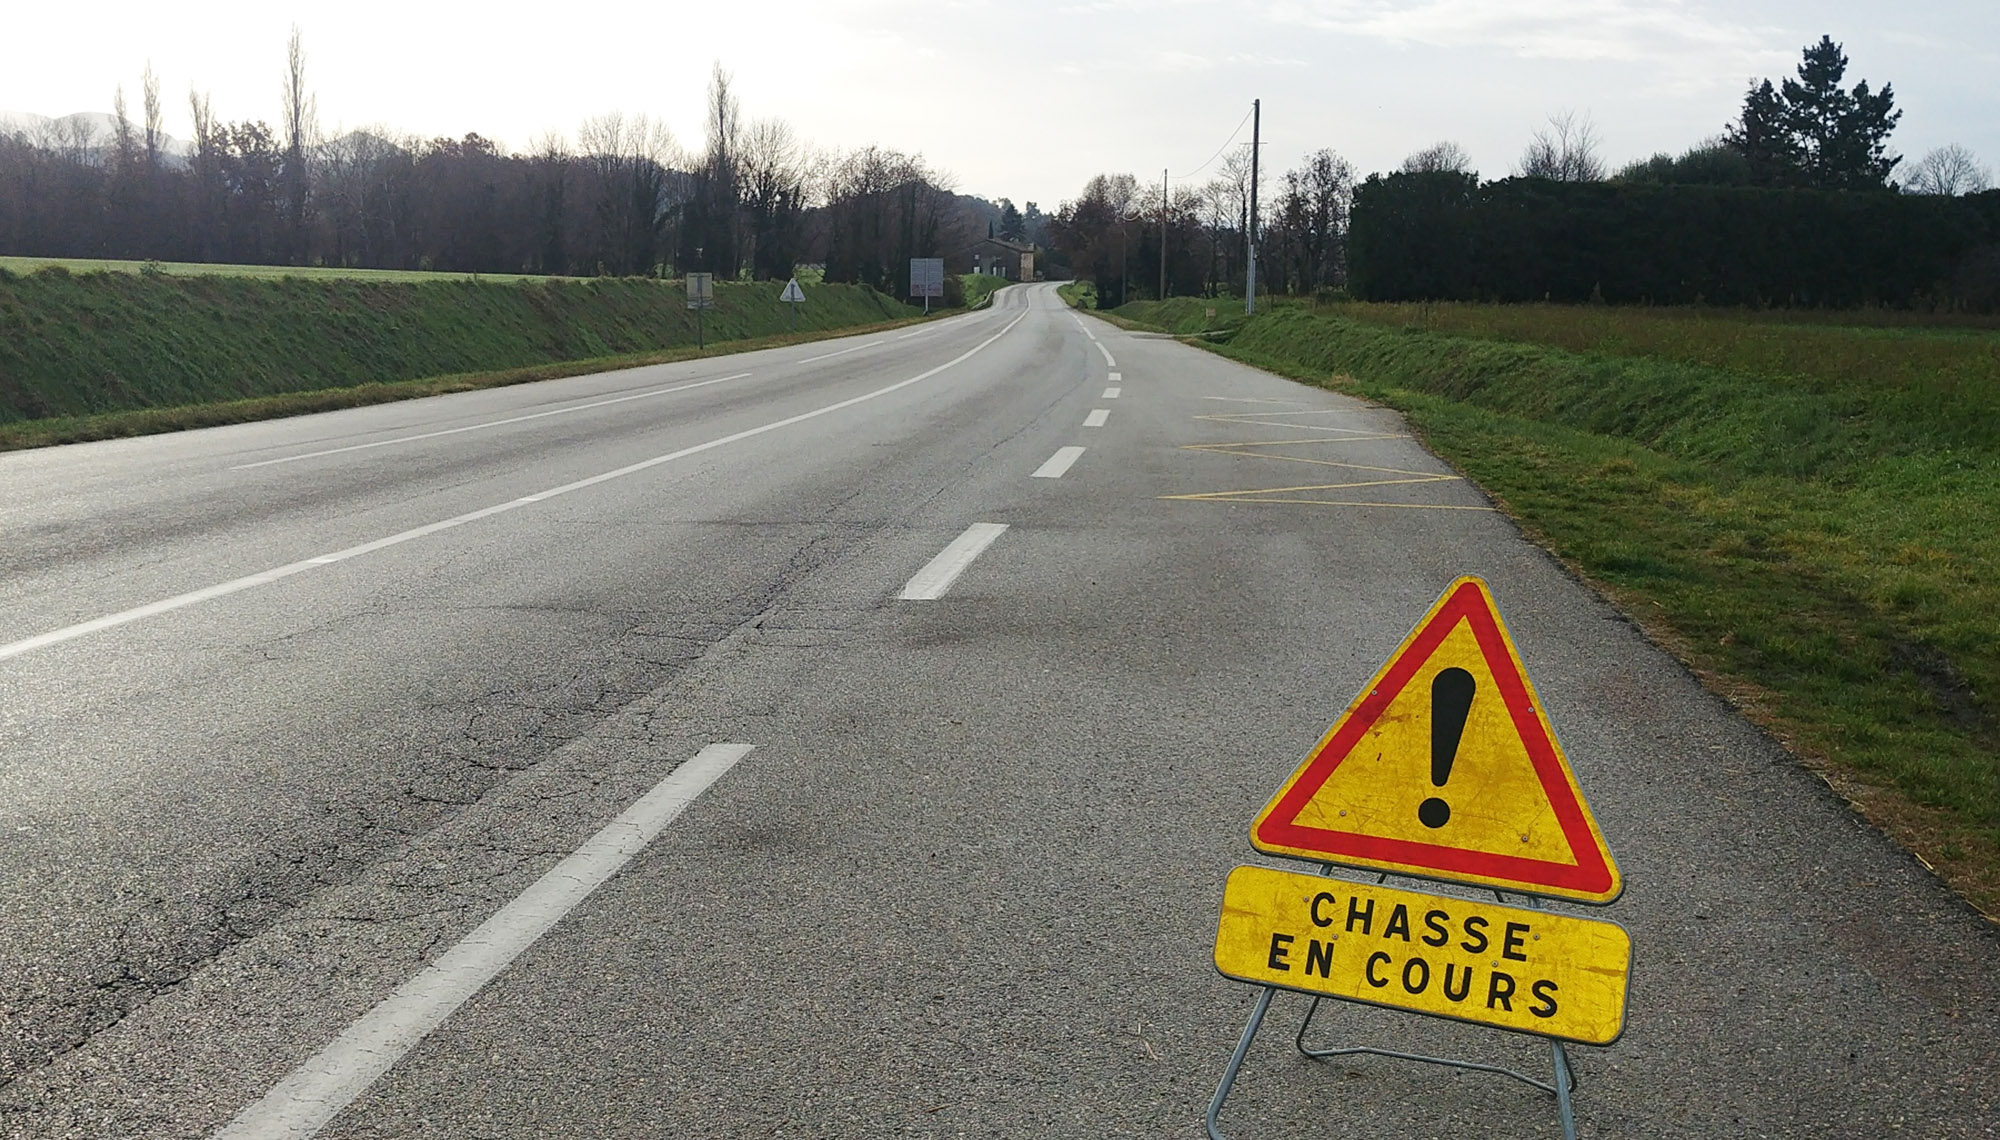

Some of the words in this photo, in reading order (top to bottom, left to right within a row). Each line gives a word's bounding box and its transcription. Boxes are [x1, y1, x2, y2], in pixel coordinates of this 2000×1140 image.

[1310, 892, 1531, 962] CHASSE
[1267, 933, 1335, 979] EN
[1366, 951, 1559, 1018] COURS
